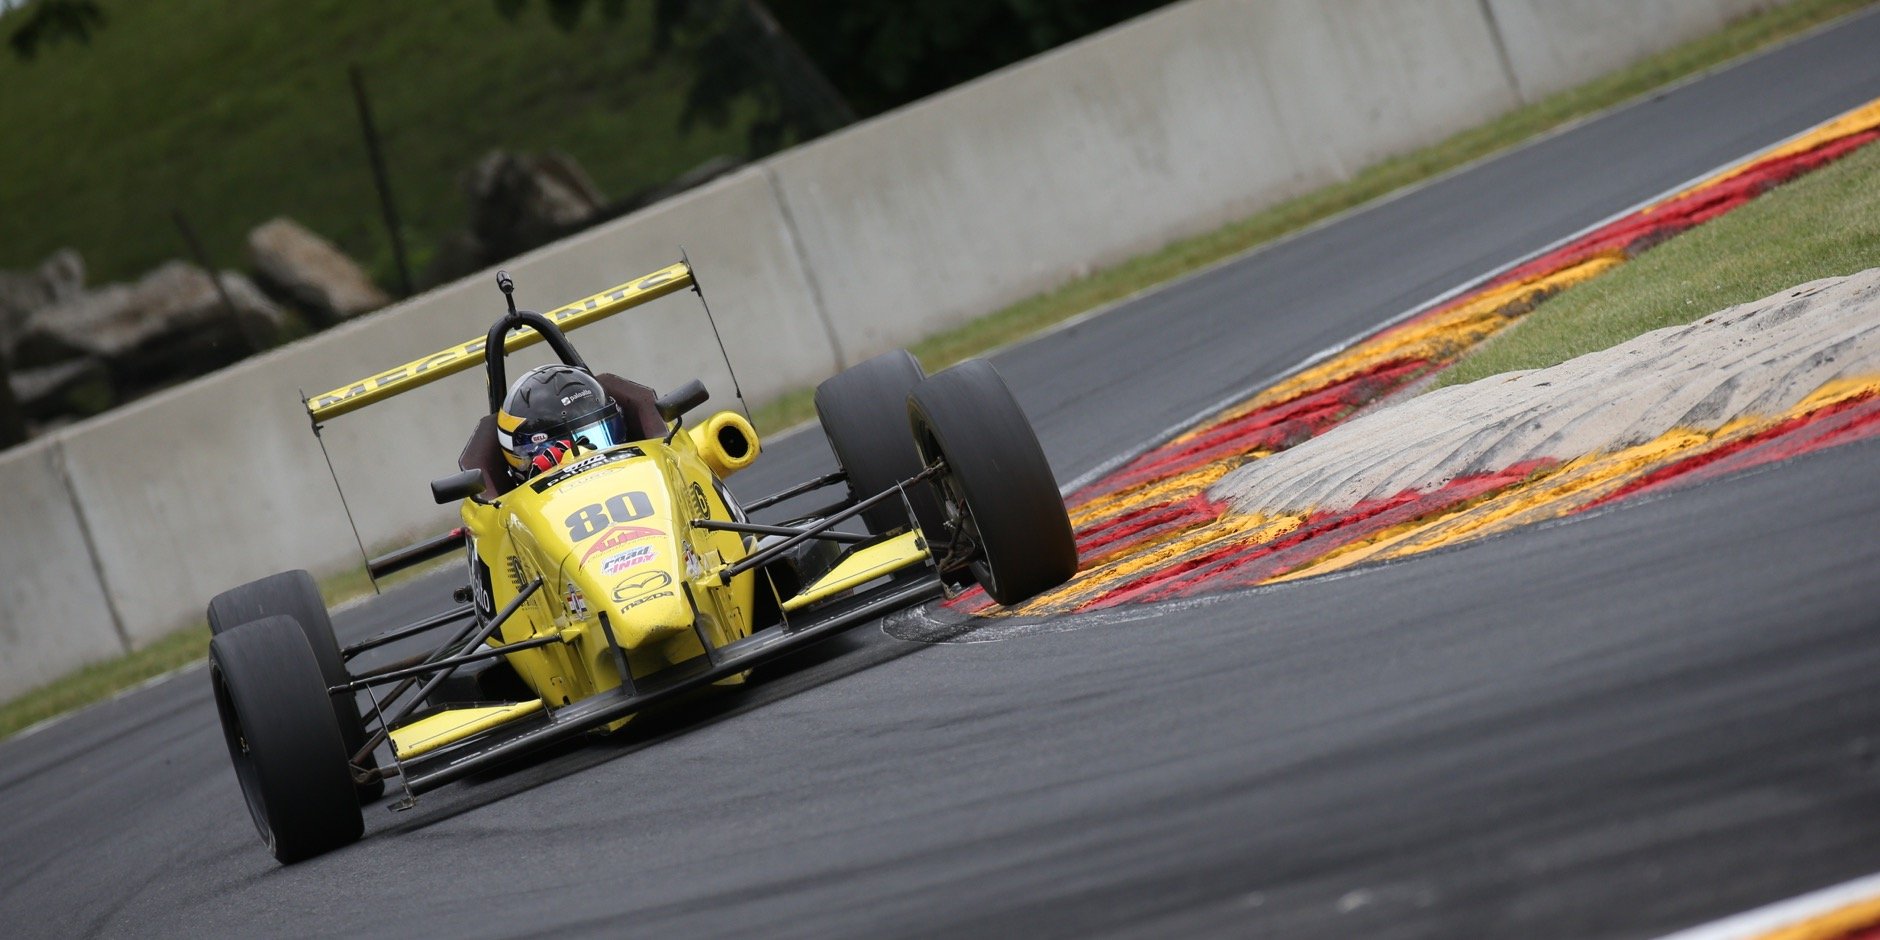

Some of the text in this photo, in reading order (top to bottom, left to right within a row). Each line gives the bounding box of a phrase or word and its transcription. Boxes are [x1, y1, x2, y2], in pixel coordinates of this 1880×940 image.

[533, 434, 546, 442] BELL
[564, 491, 655, 543] 80
[620, 591, 674, 614] mazda
